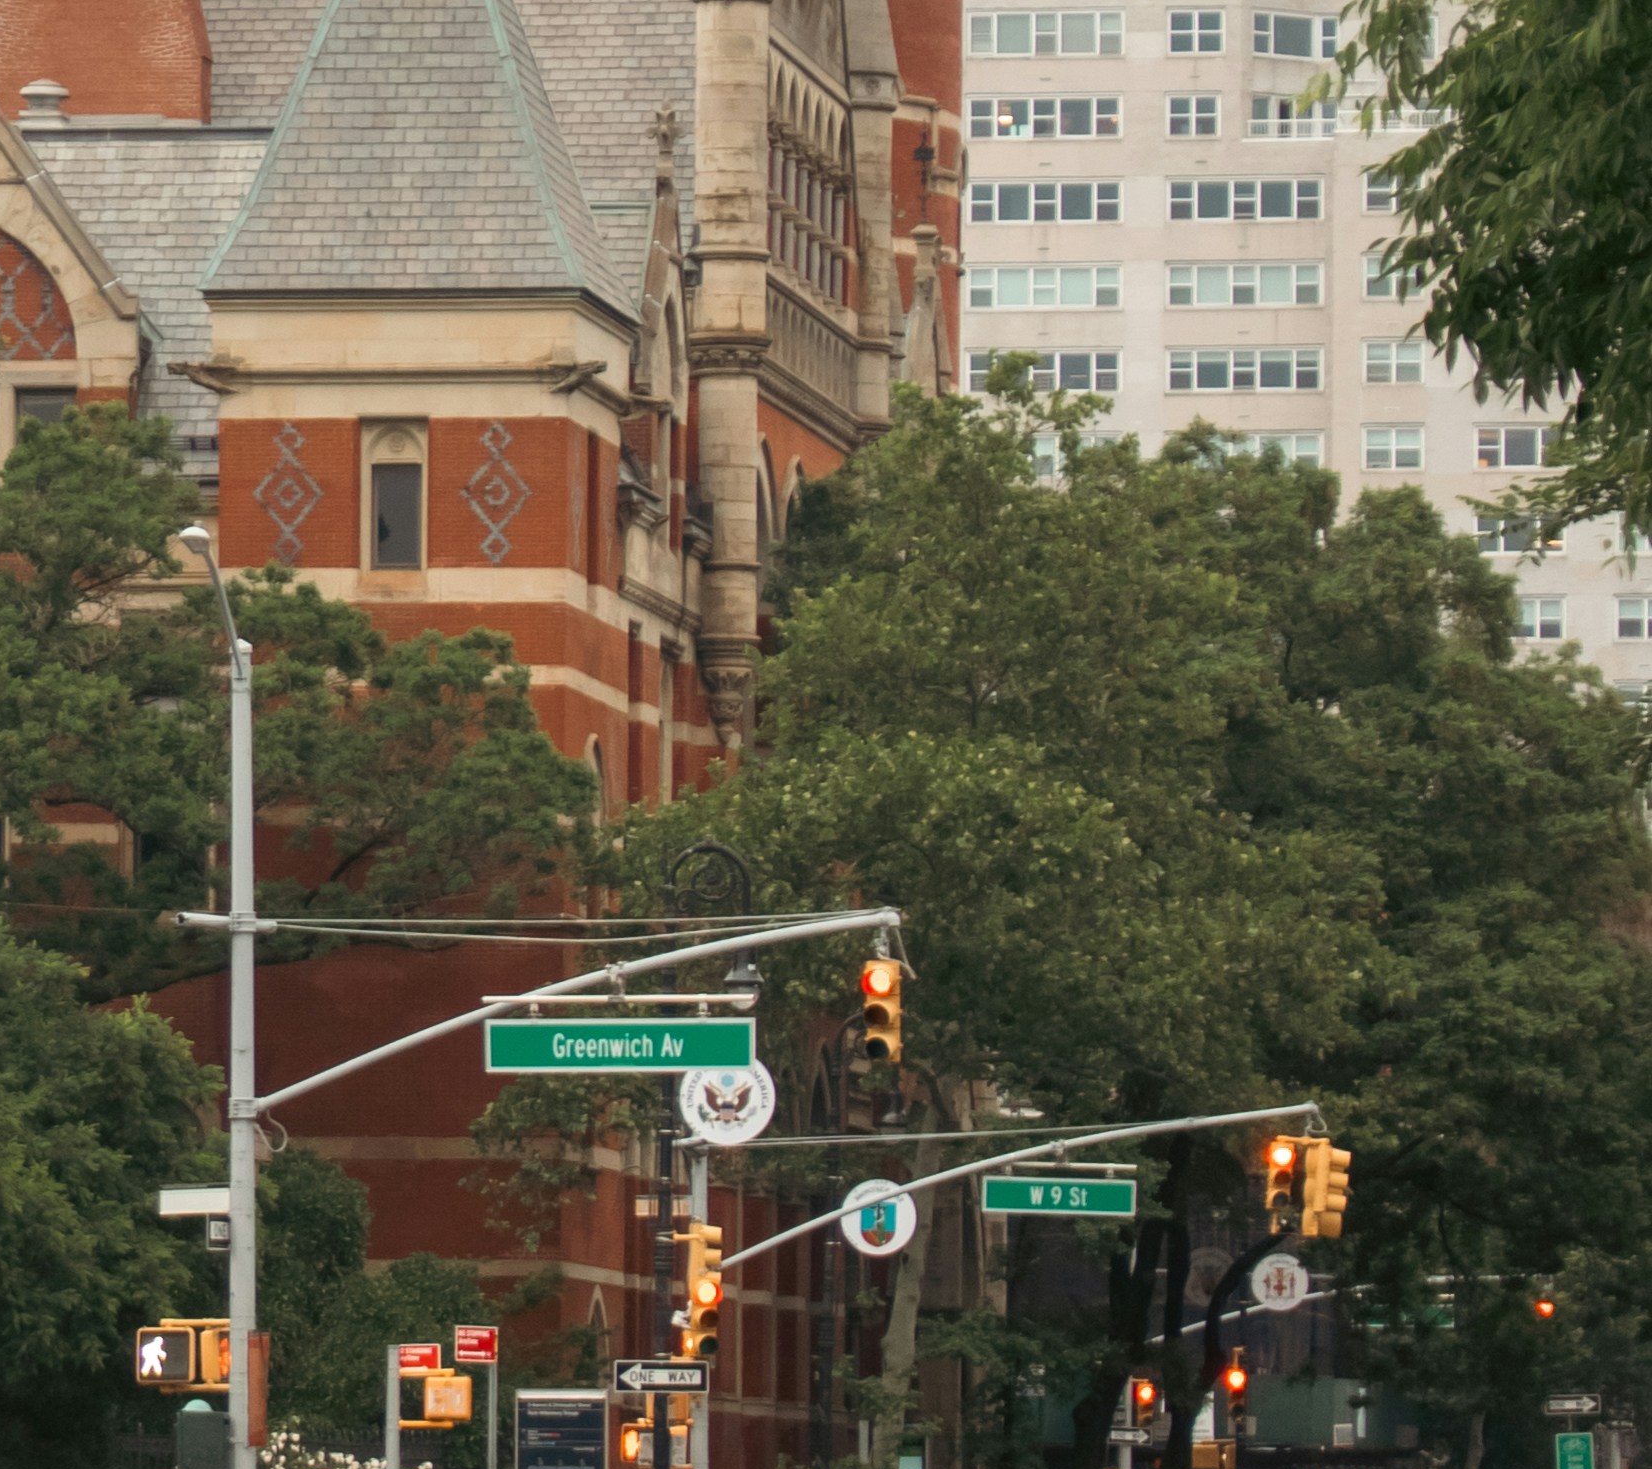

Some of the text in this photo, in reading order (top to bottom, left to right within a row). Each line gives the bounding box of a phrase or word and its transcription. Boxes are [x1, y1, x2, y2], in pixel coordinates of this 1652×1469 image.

[552, 1032, 684, 1059] Greenwich Av
[1029, 1185, 1088, 1207] W 9 St
[629, 1370, 695, 1383] ONE WAY
